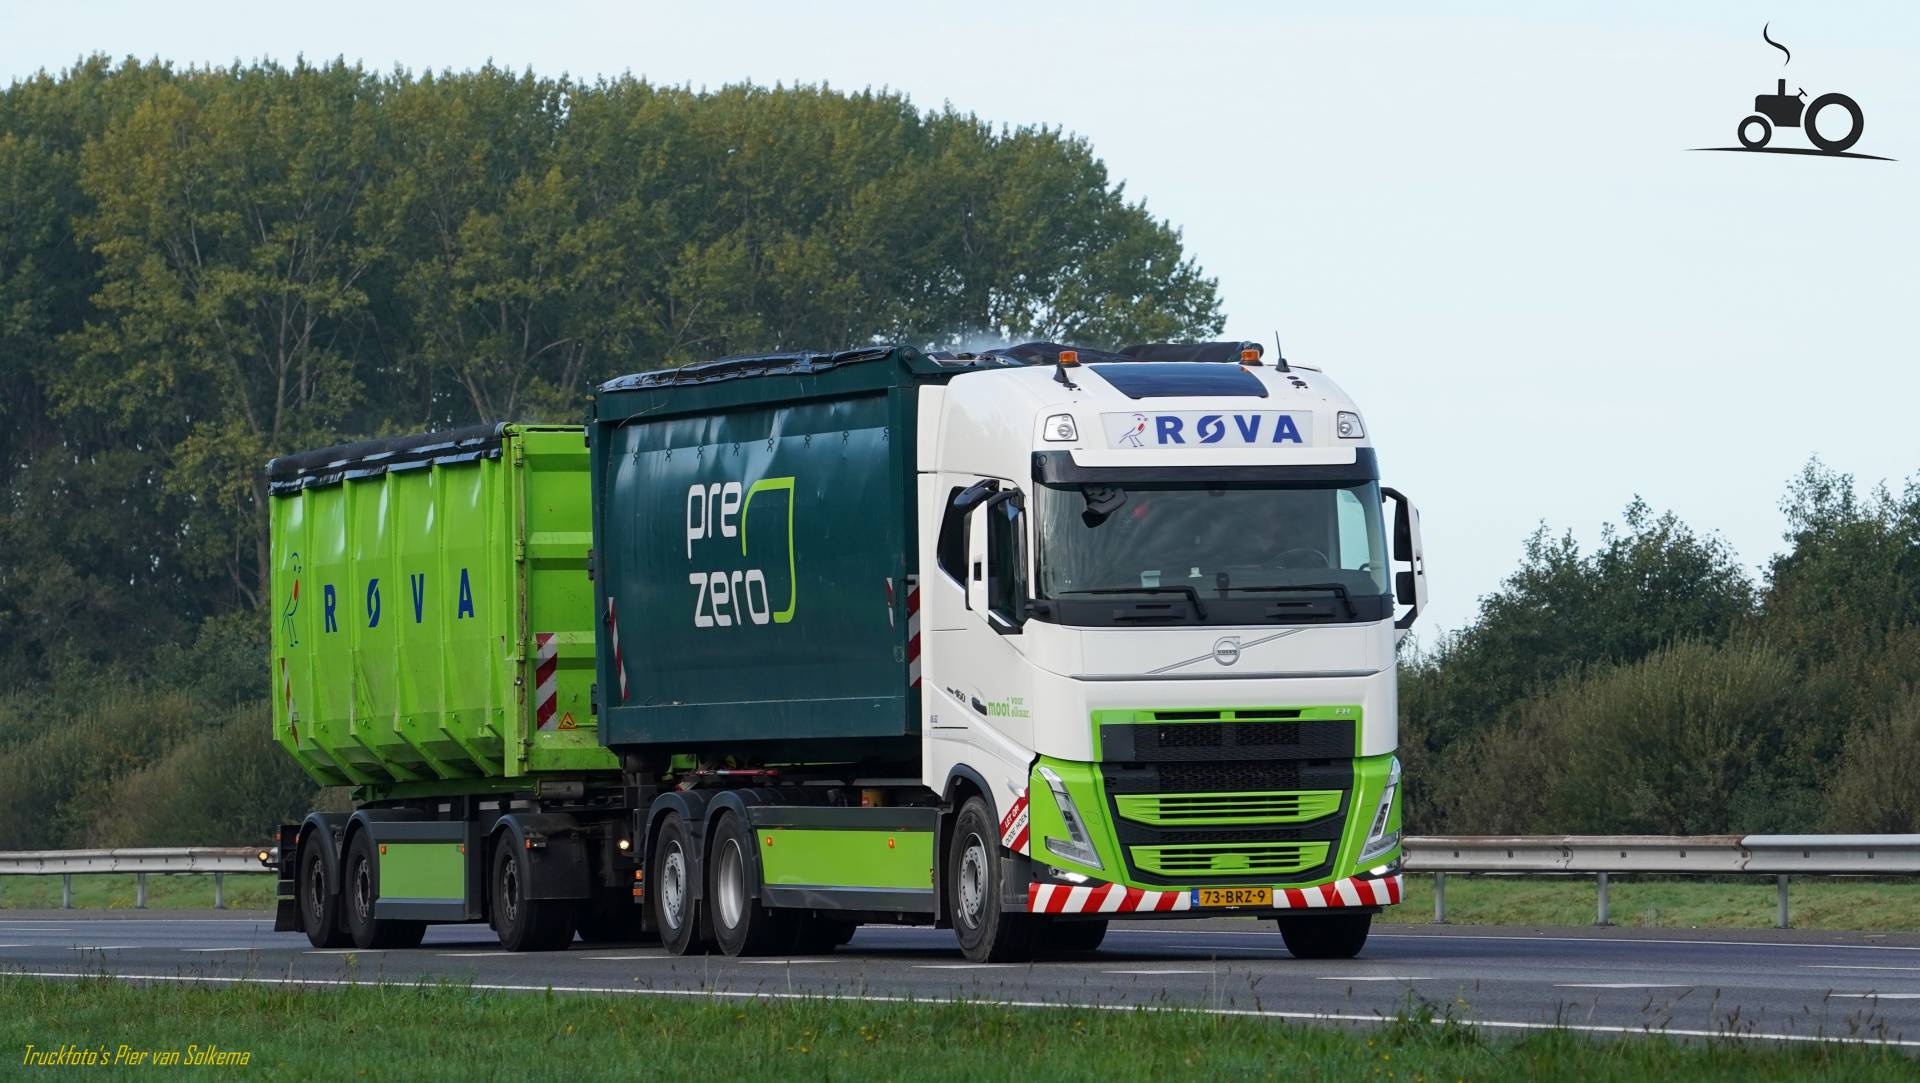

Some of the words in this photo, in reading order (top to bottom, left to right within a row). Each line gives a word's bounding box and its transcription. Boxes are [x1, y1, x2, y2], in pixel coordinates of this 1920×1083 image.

[686, 481, 742, 560] pre
[689, 569, 770, 628] zero
[988, 697, 1010, 717] mooi
[1204, 890, 1266, 904] 73-BRZ-9
